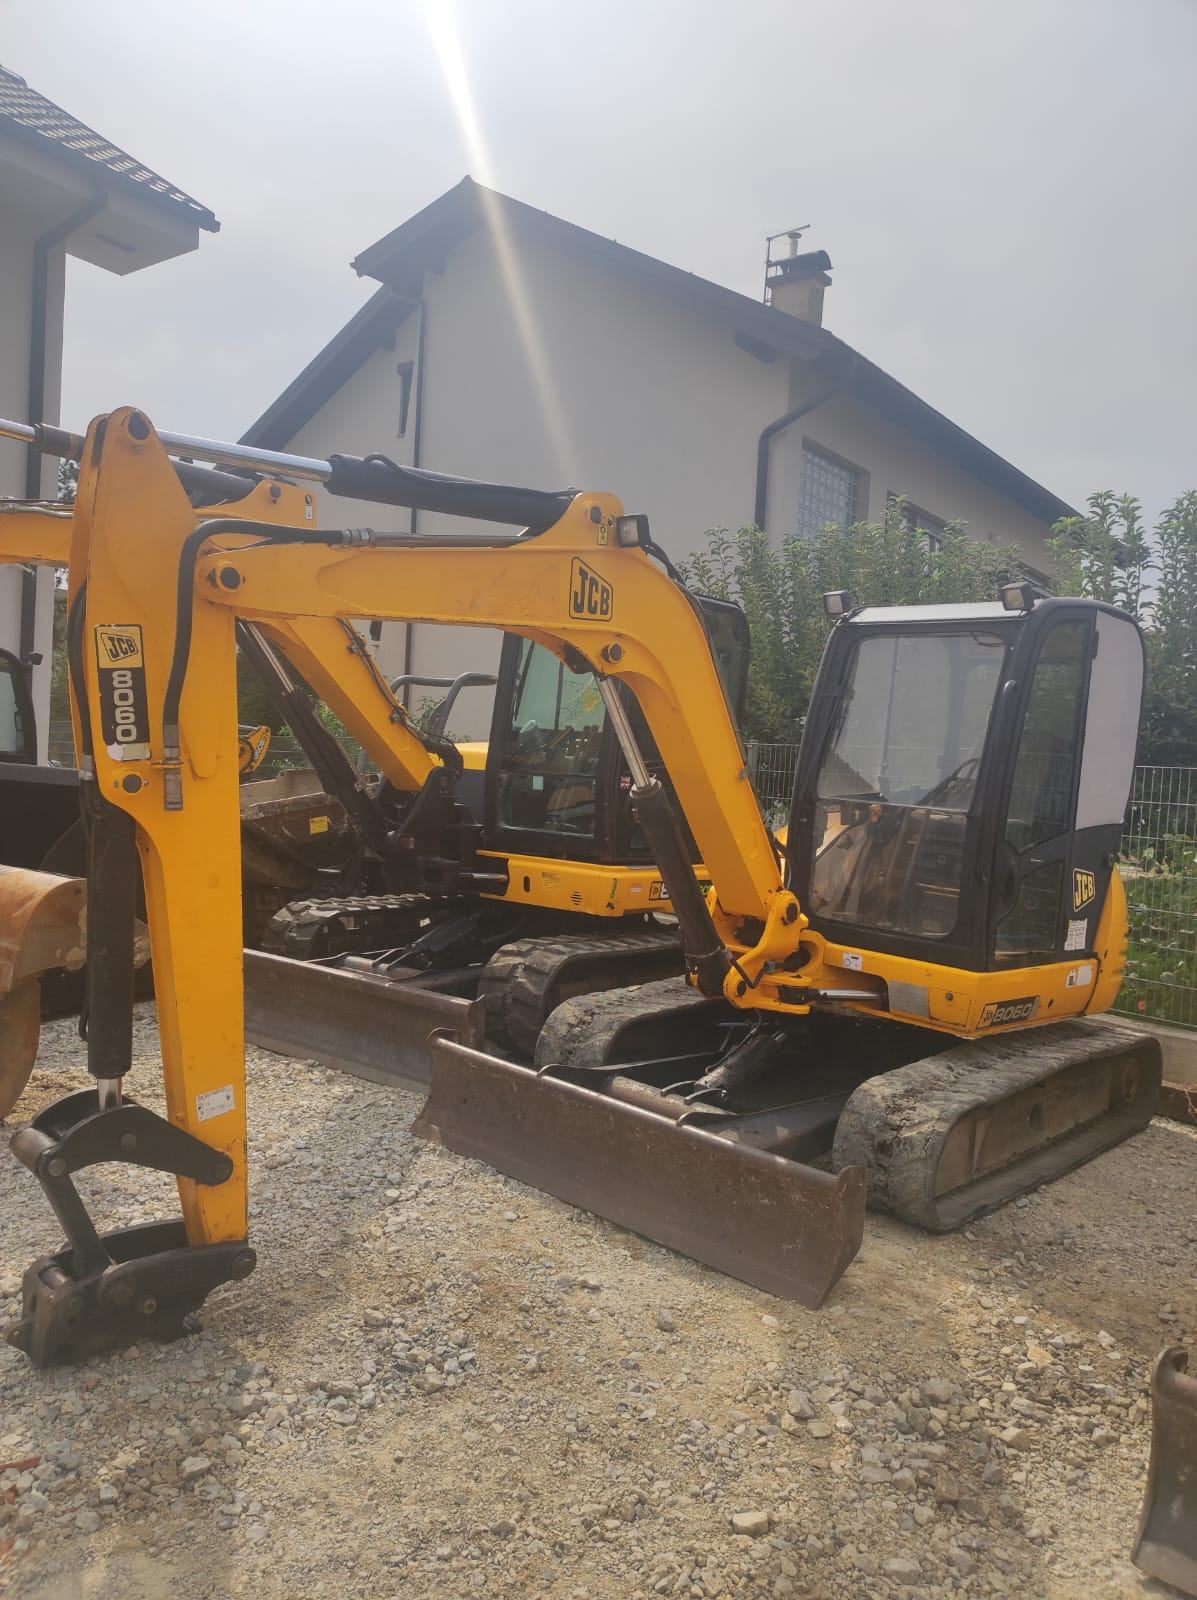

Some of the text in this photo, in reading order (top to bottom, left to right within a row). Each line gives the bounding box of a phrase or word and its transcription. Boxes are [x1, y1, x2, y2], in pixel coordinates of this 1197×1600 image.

[573, 566, 609, 615] JCB
[107, 636, 136, 659] JCB
[112, 670, 137, 742] 8060
[1074, 873, 1094, 907] JCB
[992, 1003, 1033, 1022] 8060
